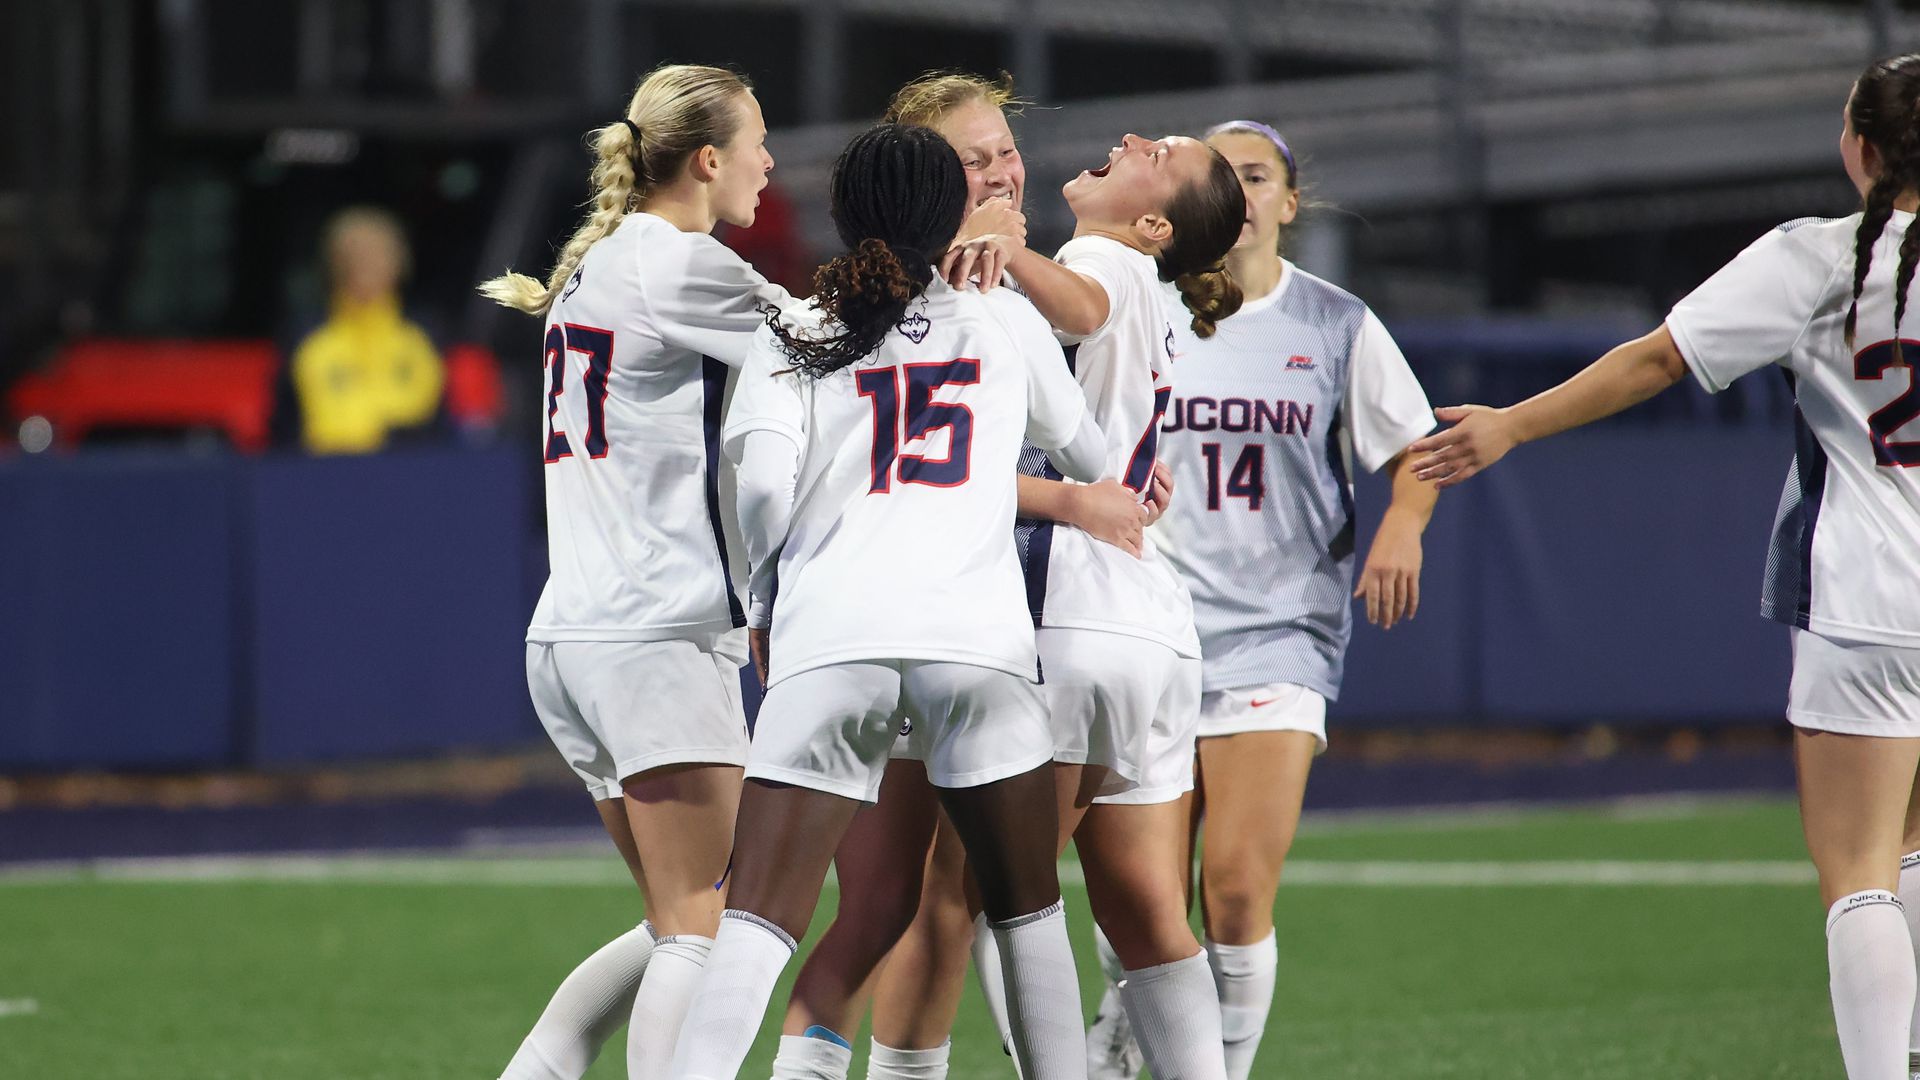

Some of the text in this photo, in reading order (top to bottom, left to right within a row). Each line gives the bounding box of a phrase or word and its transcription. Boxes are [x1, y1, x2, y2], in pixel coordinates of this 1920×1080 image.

[544, 322, 614, 464] 27
[855, 357, 981, 496] 15
[1161, 396, 1313, 438] UCONN
[1201, 442, 1265, 511] 14
[1849, 894, 1887, 905] NIKE
